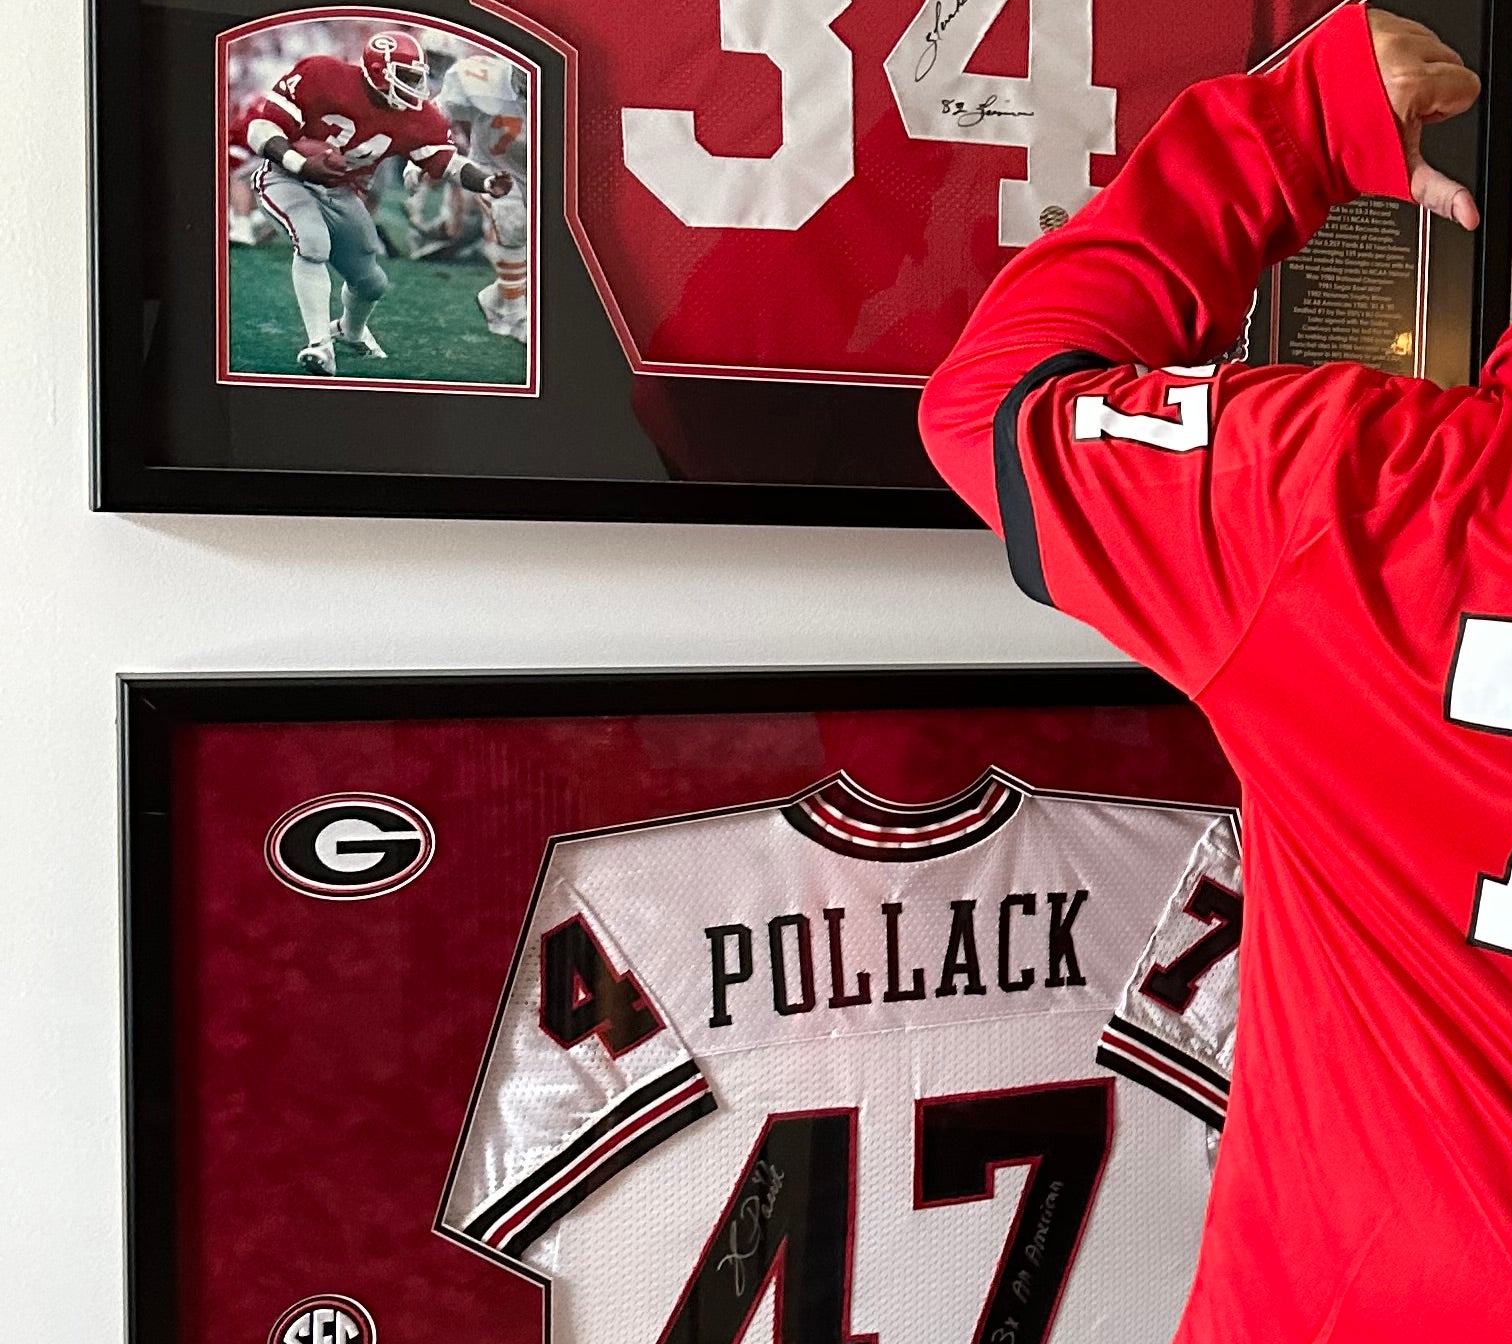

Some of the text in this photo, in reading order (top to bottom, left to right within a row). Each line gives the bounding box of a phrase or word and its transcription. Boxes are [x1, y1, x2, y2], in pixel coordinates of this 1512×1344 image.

[537, 911, 668, 1062] 4
[704, 889, 1090, 1029] POLLACK
[1138, 874, 1244, 1016] 7
